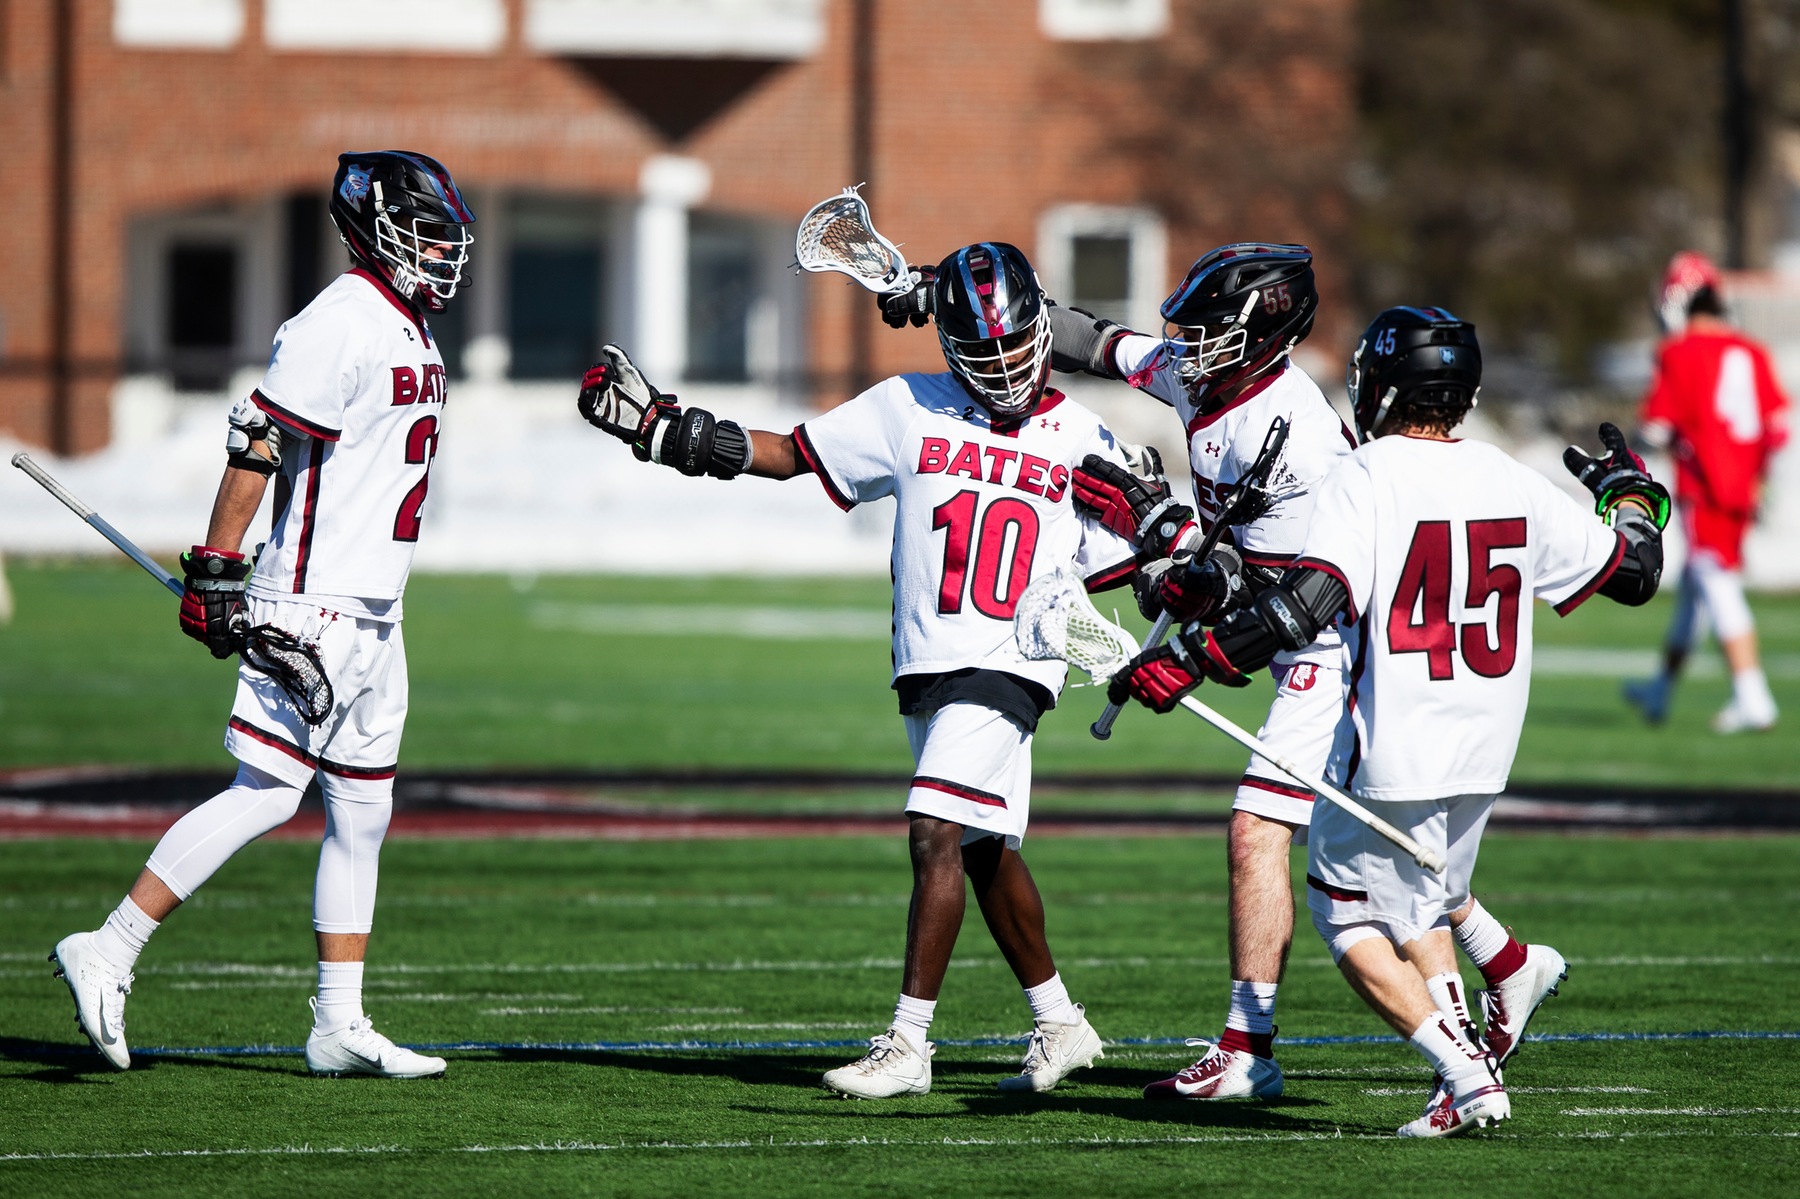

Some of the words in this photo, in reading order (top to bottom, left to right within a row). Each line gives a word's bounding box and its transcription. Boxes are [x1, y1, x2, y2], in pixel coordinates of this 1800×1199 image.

[394, 272, 415, 297] MC
[1262, 283, 1293, 316] 55
[403, 327, 415, 341] 2
[1375, 328, 1397, 356] 45
[390, 363, 447, 407] BAT
[1715, 345, 1761, 443] 4
[962, 405, 975, 421] 2
[392, 414, 440, 542] 2
[915, 436, 1069, 504] BATES
[932, 488, 1040, 622] 10
[1386, 516, 1527, 681] 45
